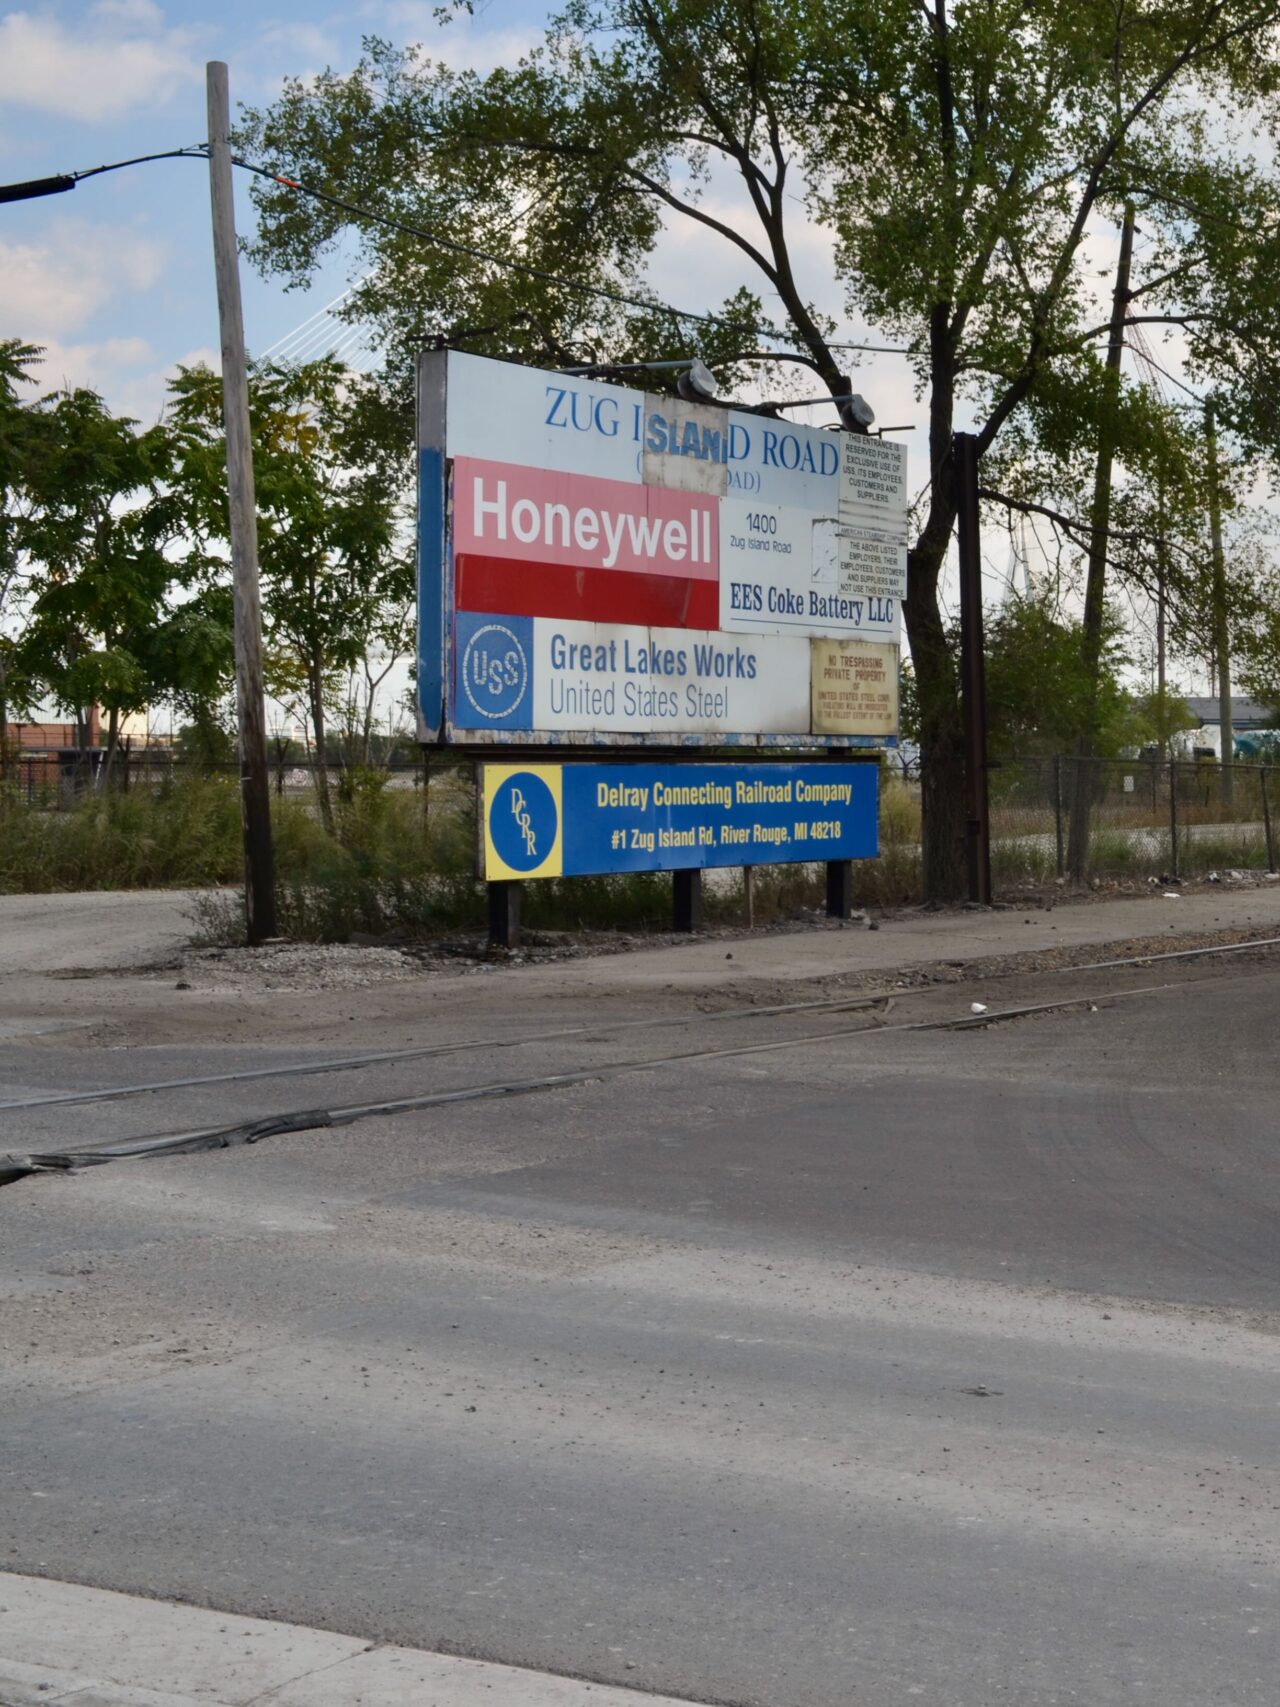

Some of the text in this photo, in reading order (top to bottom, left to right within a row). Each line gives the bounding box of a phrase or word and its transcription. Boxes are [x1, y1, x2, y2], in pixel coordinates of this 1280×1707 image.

[545, 386, 619, 437] ZUG
[761, 430, 839, 476] ROAD
[848, 433, 900, 452] THIS ENTRANCE IS
[845, 443, 901, 463] RESERVED FOR THE
[846, 455, 900, 472] EXCLUSIVE USE OF
[857, 468, 867, 477] ITS
[848, 477, 898, 494] CUSTOMERS AND
[473, 477, 711, 567] Honeywell
[746, 513, 777, 534] 1400
[730, 536, 792, 553] Zug Island Road
[850, 541, 898, 556] THE ABOVE LISTED
[884, 556, 898, 565] THEIR
[848, 574, 900, 586] AND SUPPLIERS MAY
[875, 566, 905, 577] CUSTOMERS
[840, 583, 905, 598] NOT USE THIS ENTRANCE
[730, 582, 894, 626] EES Coke Battery LLC
[550, 633, 757, 679] Great Lakes Works
[828, 654, 883, 669] NO TRESPASSING
[474, 650, 519, 695] USS
[824, 668, 886, 682] PRIVATE PROPERTY
[853, 682, 861, 690] OF
[550, 679, 728, 719] United States Steel
[597, 780, 853, 812] Delray Connecting Railroad Company
[612, 821, 841, 853] #1 Zug Island Rd, River Rouge, MI 48218
